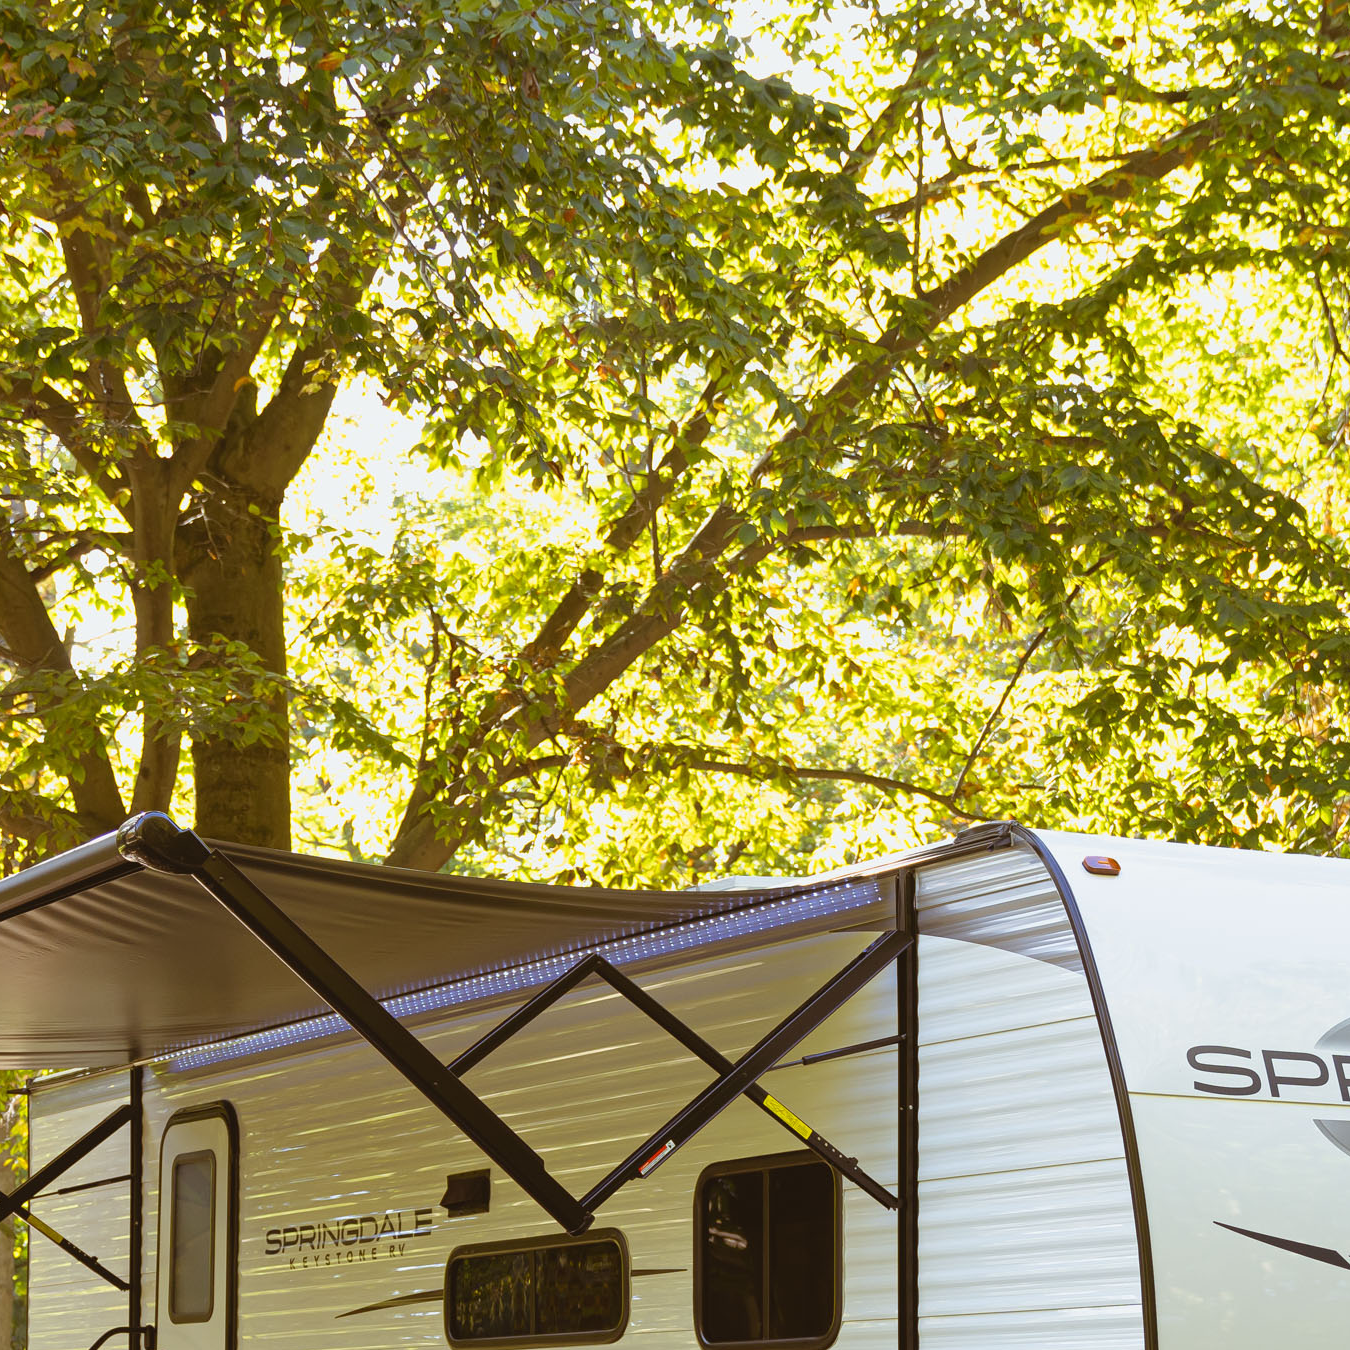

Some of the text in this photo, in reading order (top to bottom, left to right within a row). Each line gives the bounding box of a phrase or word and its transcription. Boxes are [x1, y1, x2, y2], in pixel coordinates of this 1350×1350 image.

[265, 1208, 433, 1255] SPRINGDALE
[289, 1243, 406, 1270] KEYSTONE RV
